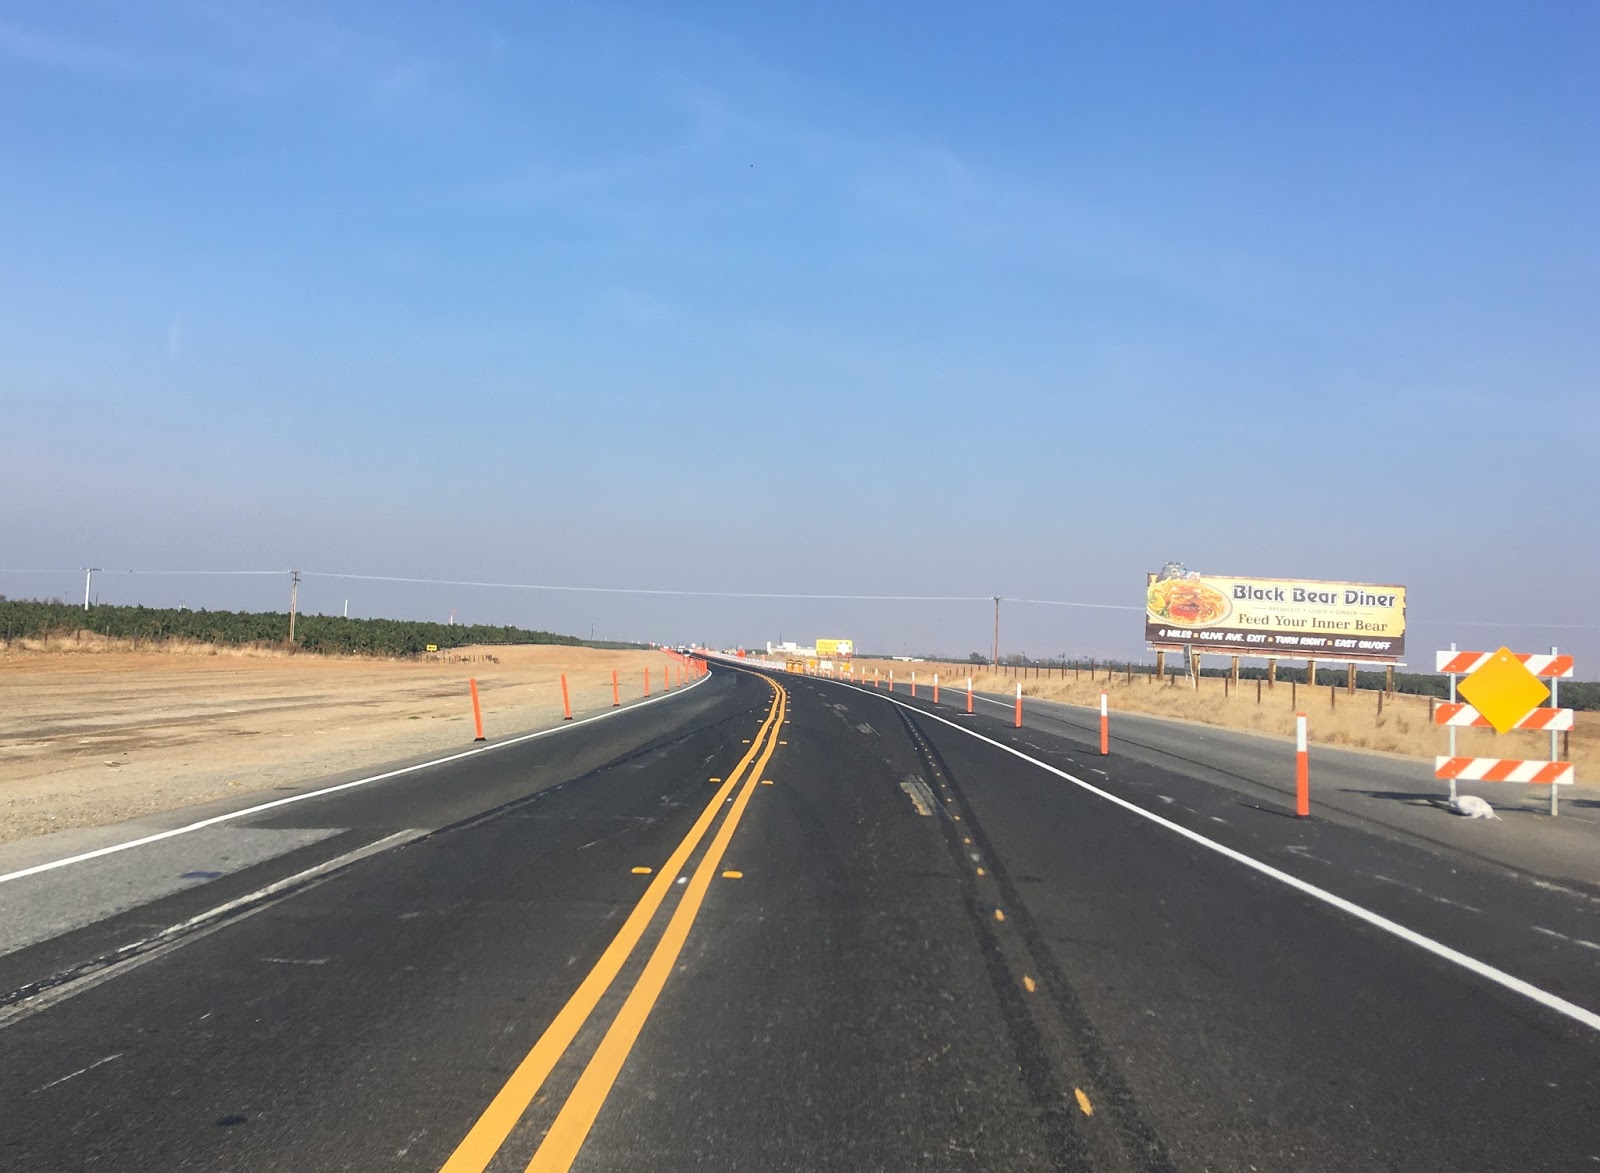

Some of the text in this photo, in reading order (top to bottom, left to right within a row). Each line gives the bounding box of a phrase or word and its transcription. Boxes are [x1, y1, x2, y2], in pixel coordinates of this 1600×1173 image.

[1233, 585, 1396, 607] Black Bear Diner
[1238, 613, 1388, 632] Feed Your Inner Bear
[1158, 629, 1392, 650] 4 MILES OLIVE AVE. EXIT TURN RIGHT EAST ON/OFF
